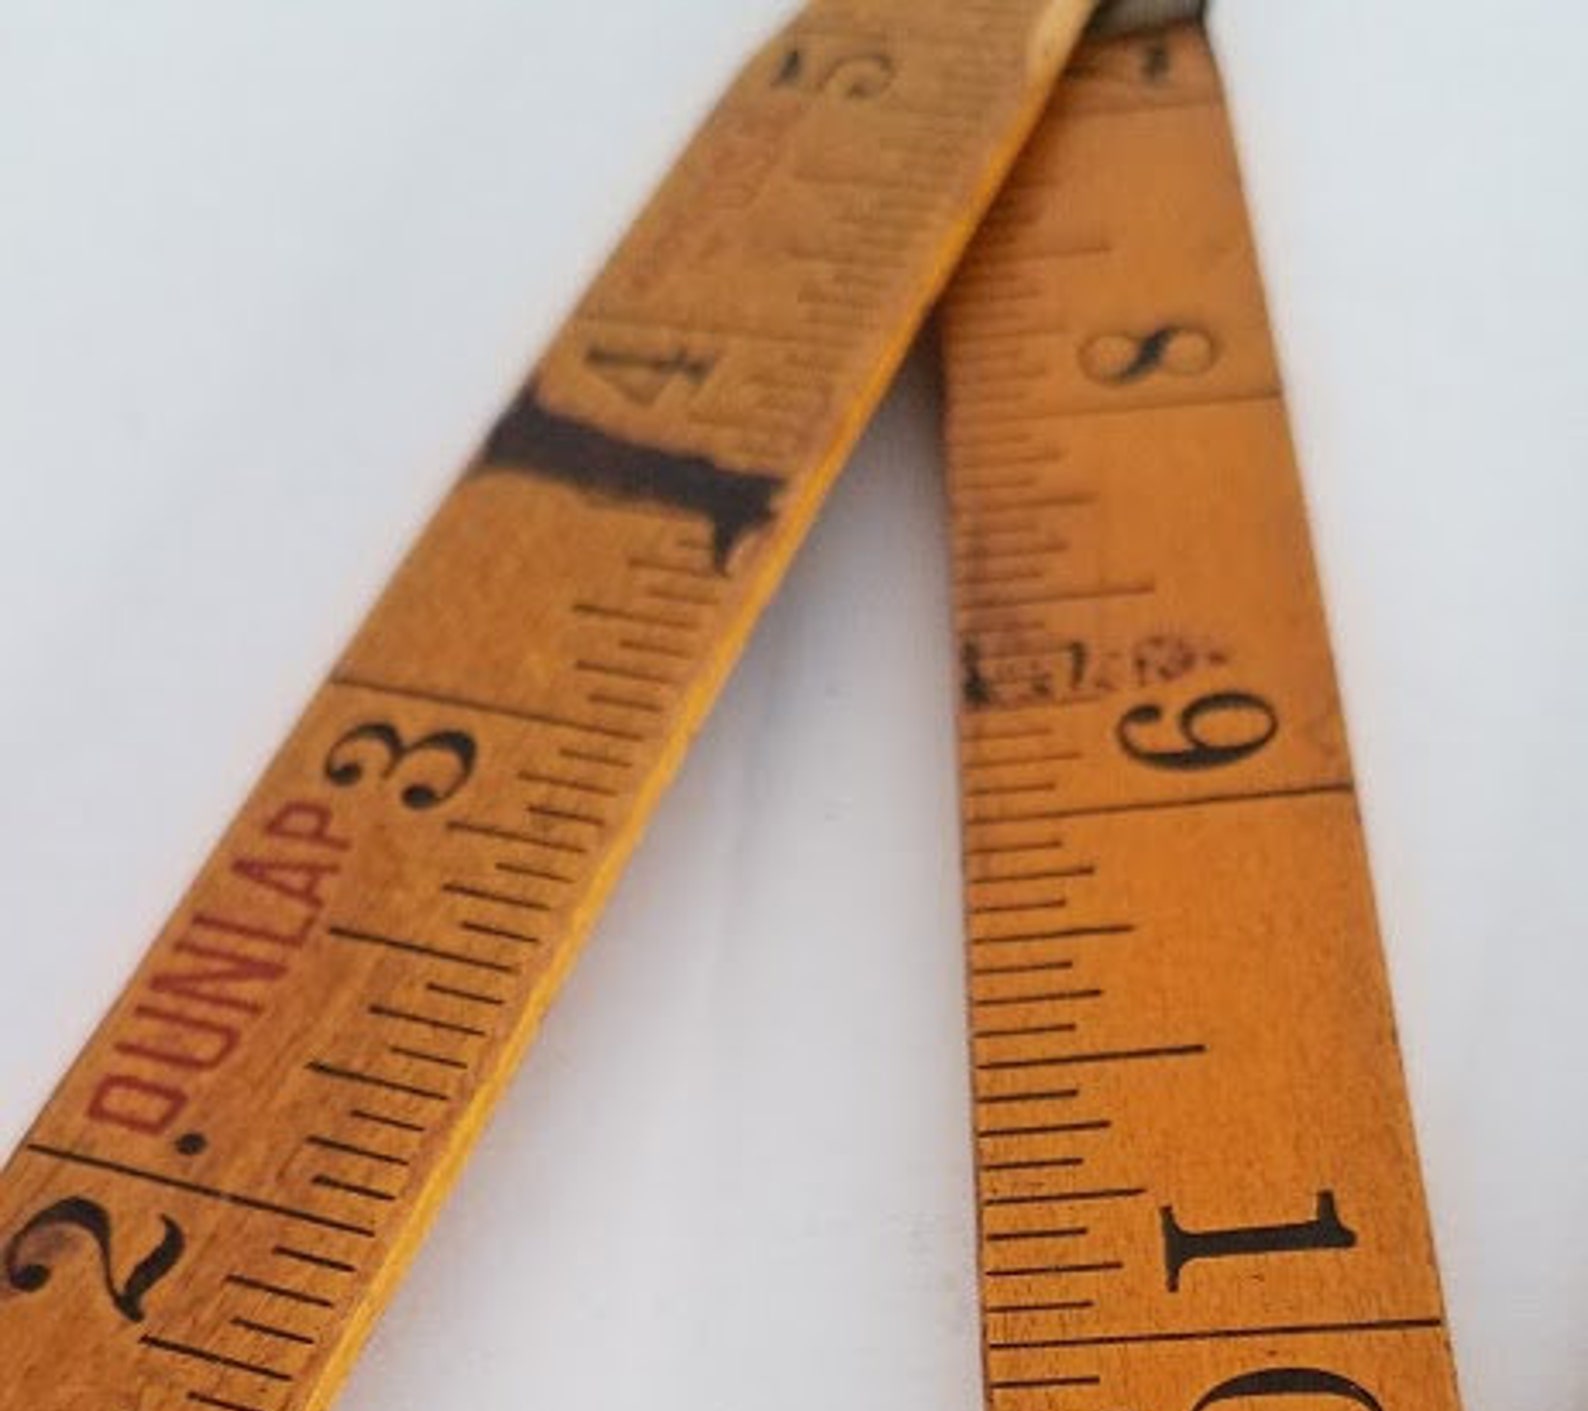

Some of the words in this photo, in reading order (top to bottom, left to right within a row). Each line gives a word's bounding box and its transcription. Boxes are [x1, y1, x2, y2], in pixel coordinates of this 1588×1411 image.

[583, 341, 720, 407] 4
[1078, 324, 1222, 387] 8
[323, 722, 478, 811] 3
[1116, 691, 1280, 771] 9
[86, 799, 352, 1137] DUNLAP
[3, 1195, 186, 1323] 2
